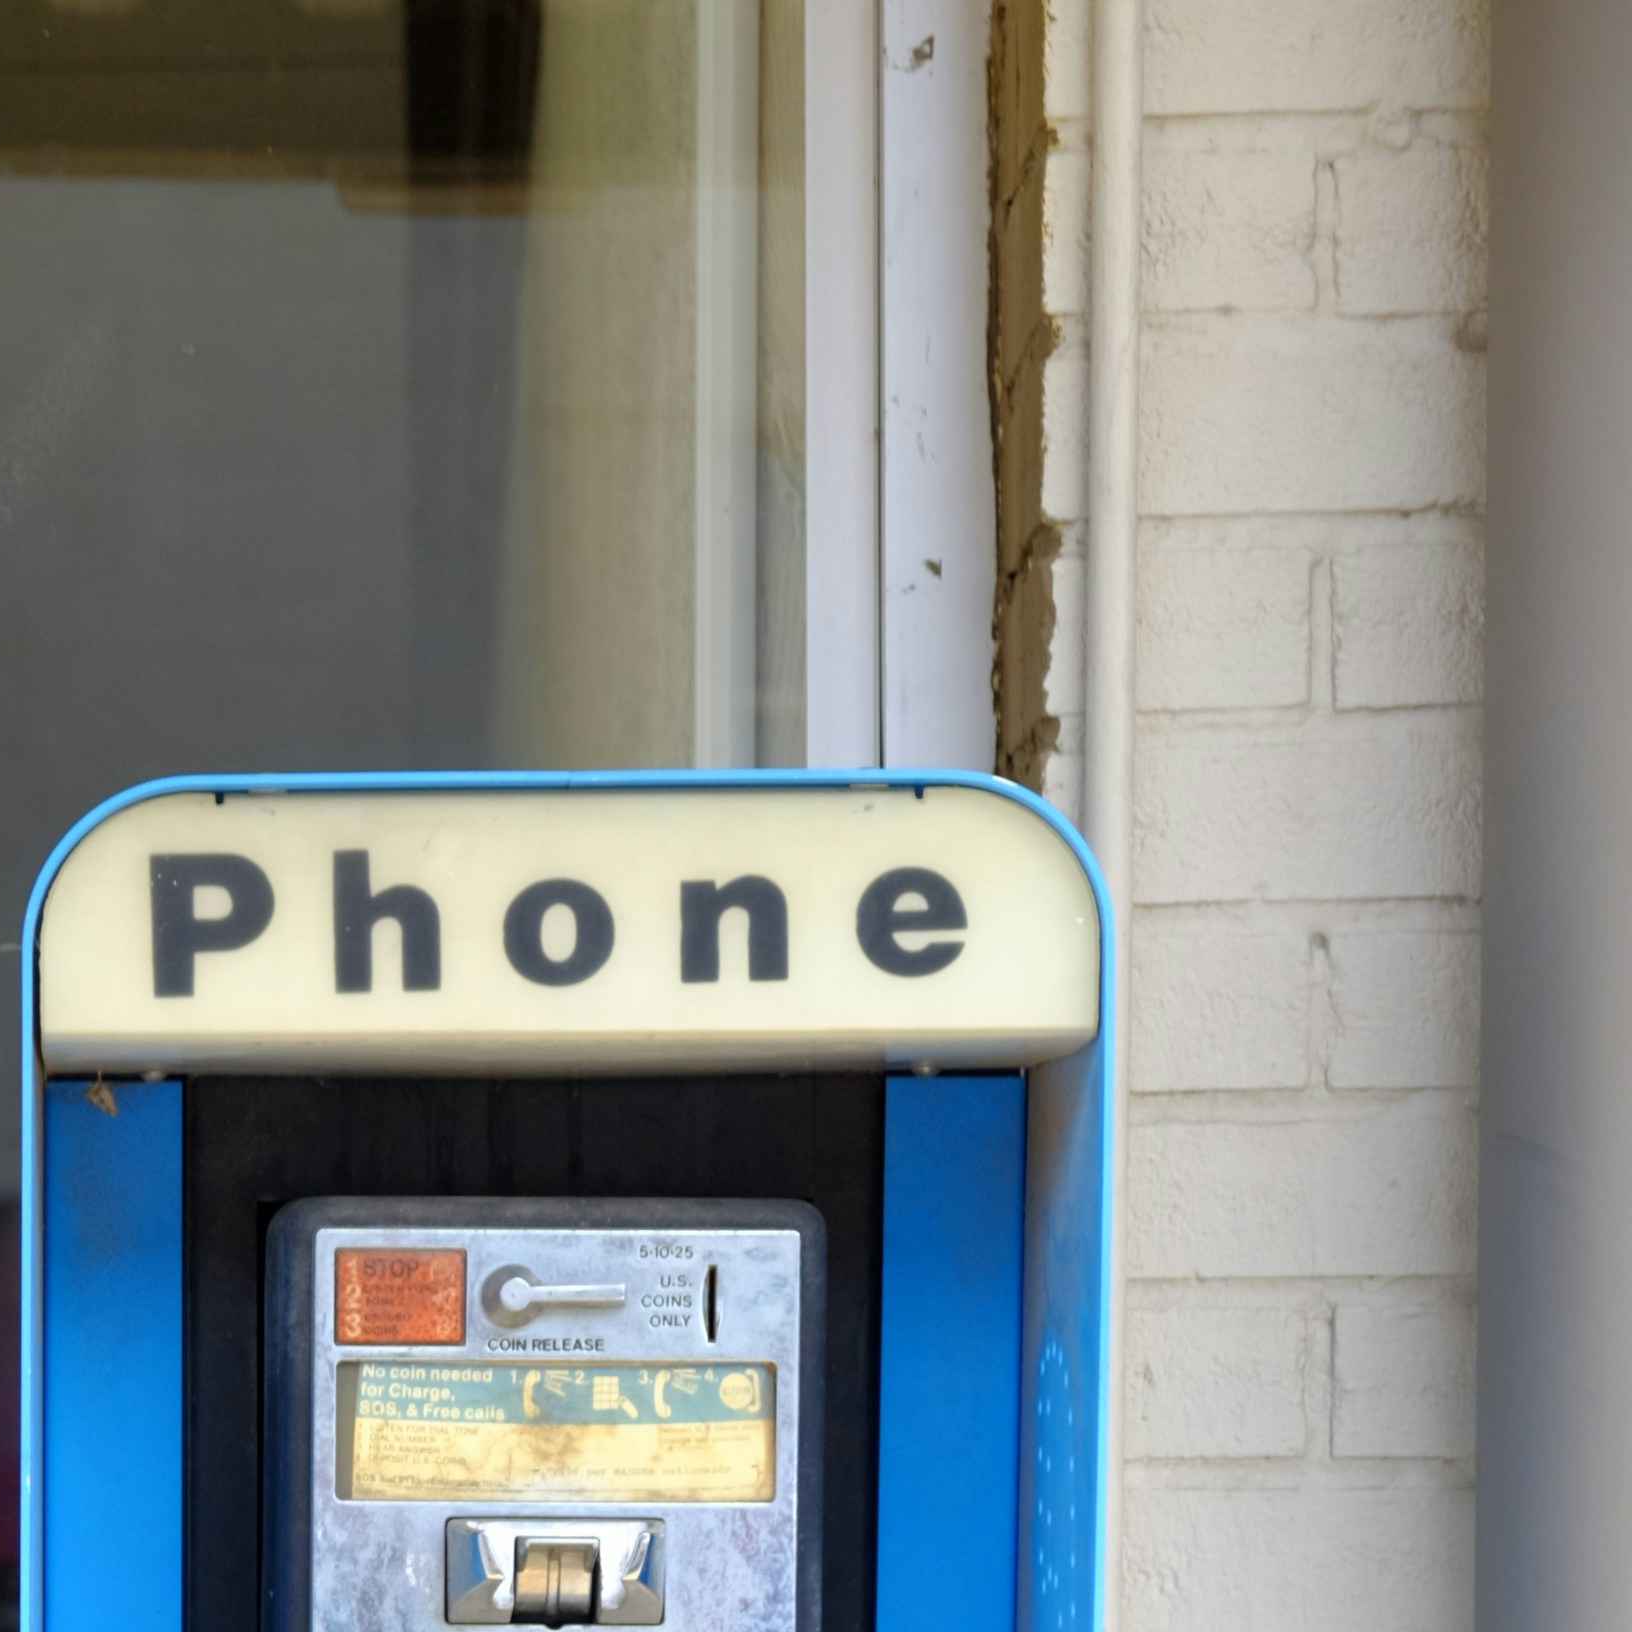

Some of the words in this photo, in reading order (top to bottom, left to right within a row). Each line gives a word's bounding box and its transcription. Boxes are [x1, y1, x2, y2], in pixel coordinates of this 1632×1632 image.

[149, 849, 969, 998] Phone
[363, 1258, 419, 1279] STOP
[660, 1274, 693, 1288] U.S.
[345, 1284, 362, 1309] 2
[641, 1295, 693, 1308] COINS
[345, 1312, 362, 1338] 3
[649, 1315, 691, 1328] ONLY
[487, 1338, 527, 1351] COIN
[532, 1338, 604, 1351] RELEASE
[362, 1365, 386, 1378] No
[390, 1365, 426, 1380] coin
[430, 1367, 493, 1383] needed
[360, 1383, 385, 1398] for
[388, 1382, 456, 1402] Charge,
[359, 1400, 402, 1418] SOS,
[406, 1404, 418, 1418] &
[423, 1403, 461, 1419] Free
[464, 1405, 506, 1421] calls
[406, 1425, 426, 1434] FOR
[455, 1427, 480, 1436] TONE
[394, 1435, 436, 1444] NUMBER
[398, 1445, 441, 1454] ANSWER
